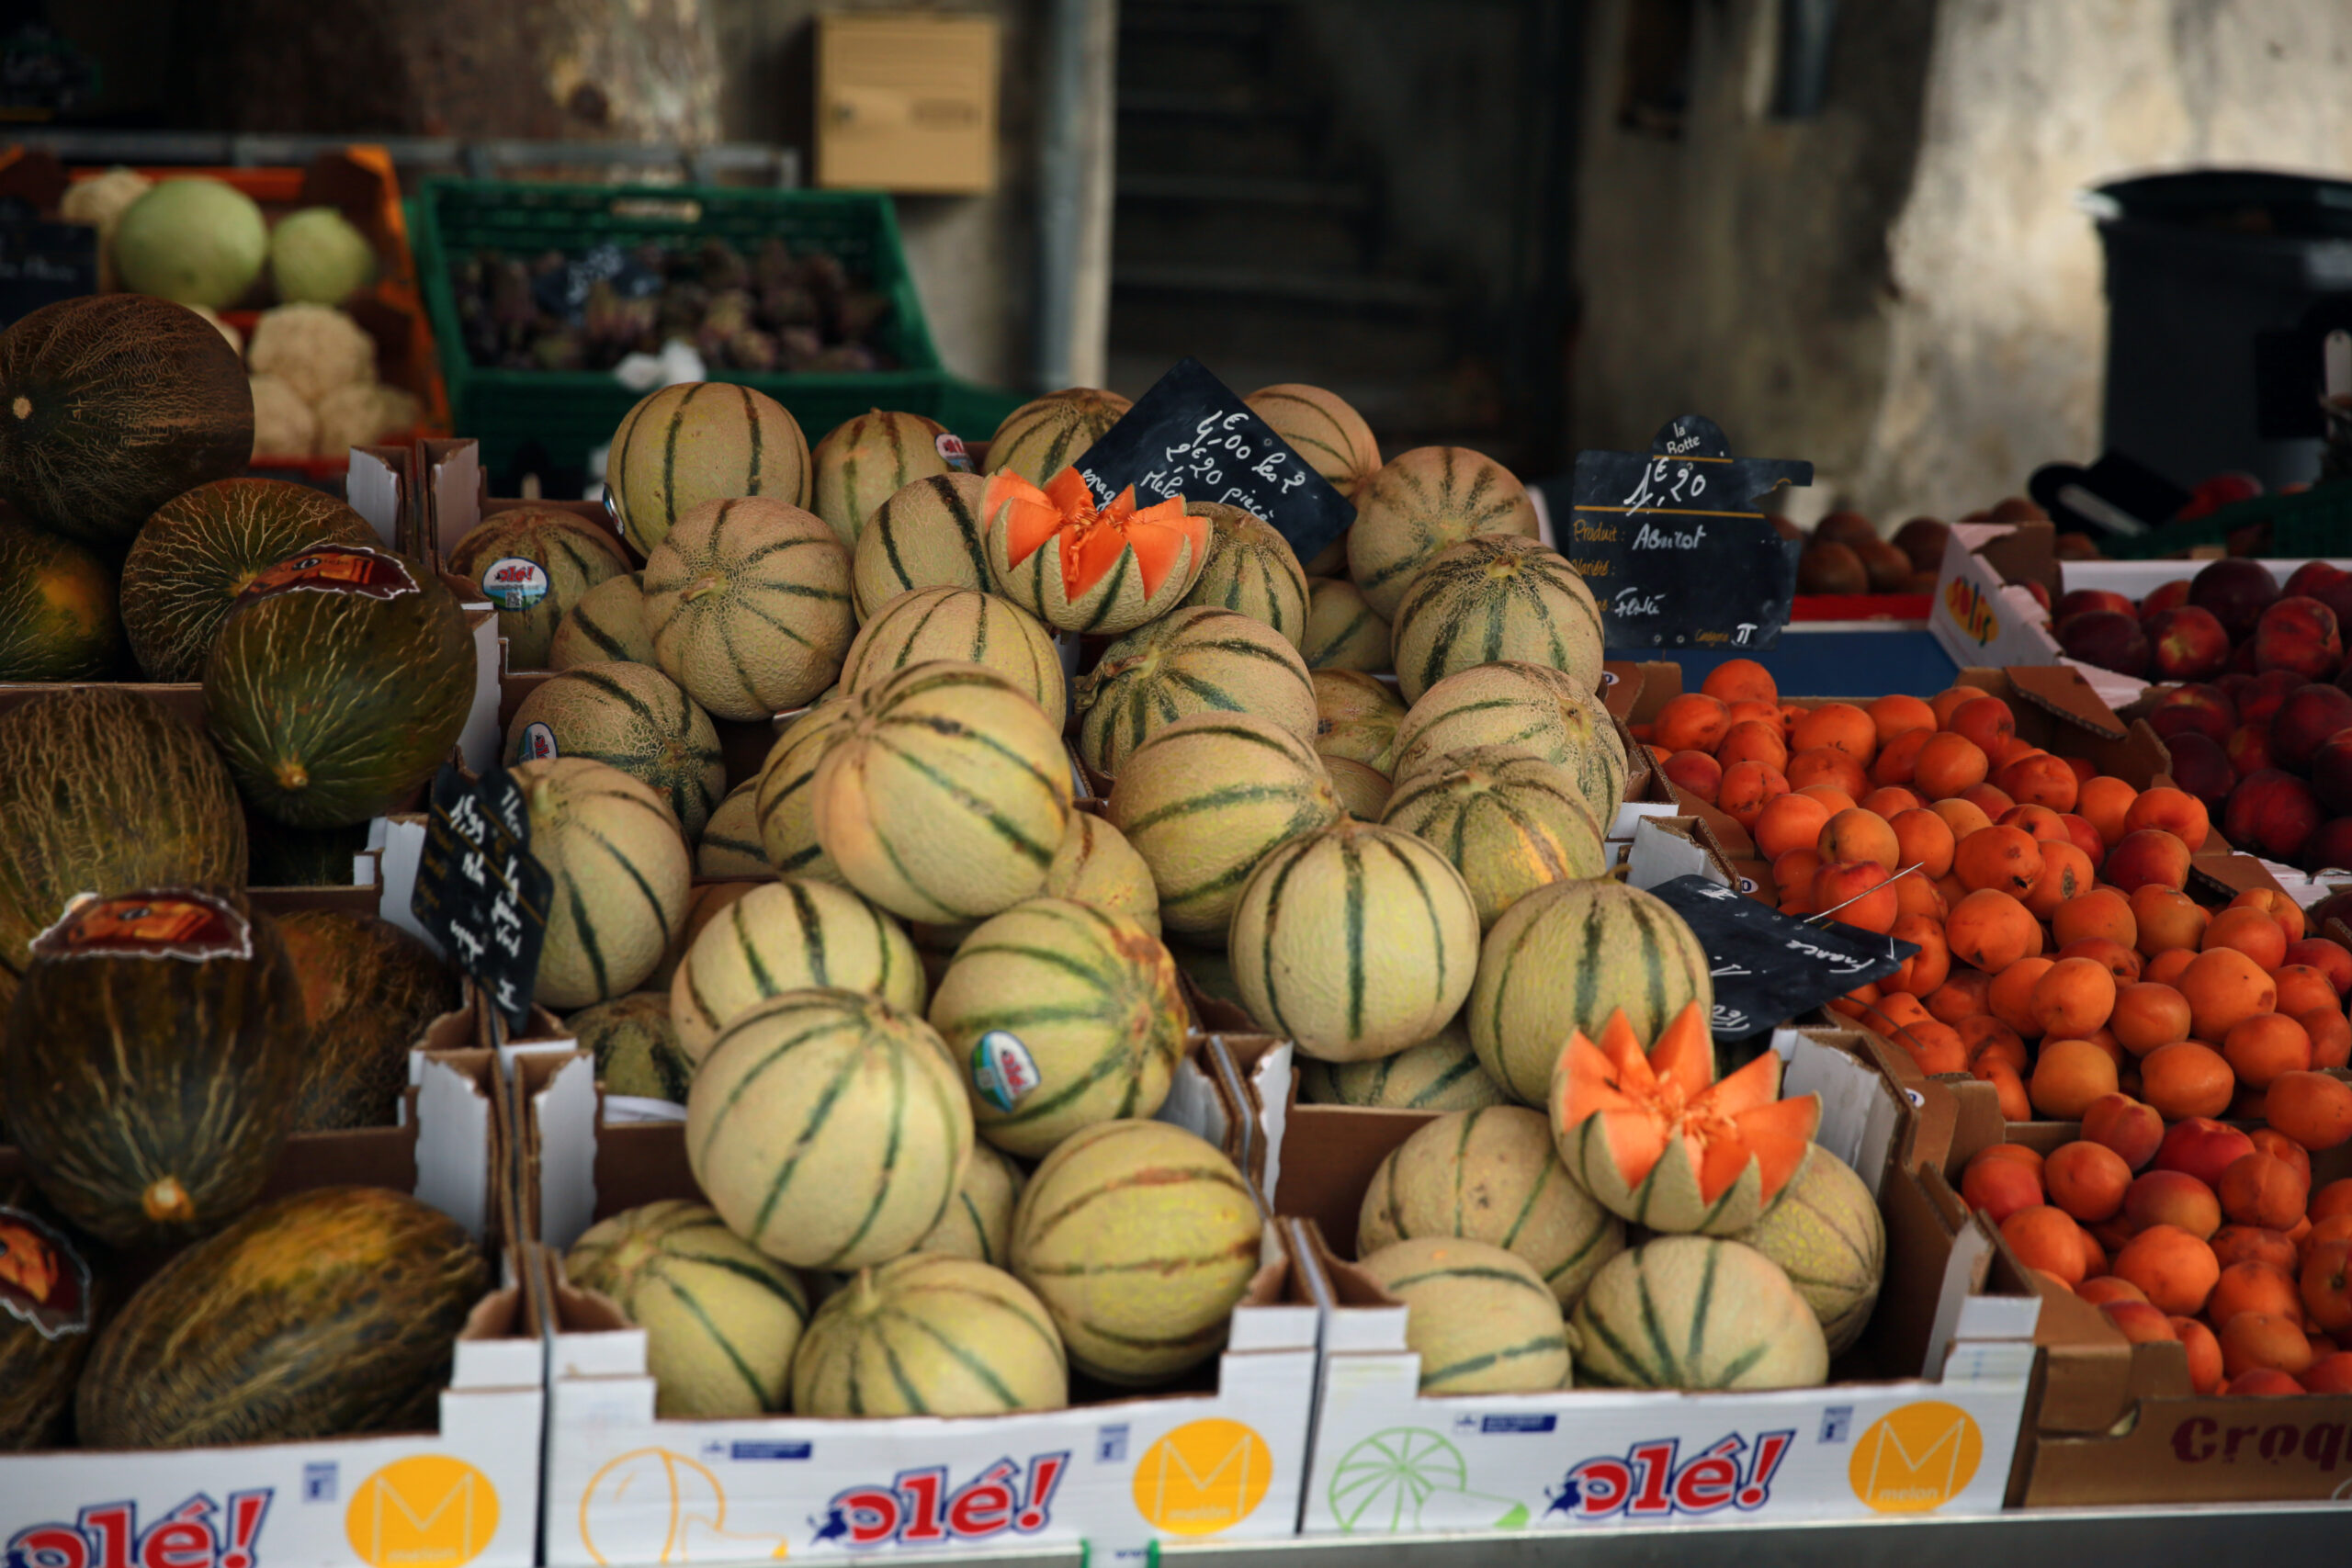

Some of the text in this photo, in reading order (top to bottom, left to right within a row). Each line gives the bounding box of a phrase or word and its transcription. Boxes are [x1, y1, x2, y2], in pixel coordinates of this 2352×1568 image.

[1667, 435, 1701, 455] Rotte
[1673, 423, 1686, 438] la
[1562, 1429, 1797, 1518] olé!
[2171, 1416, 2352, 1472] Croq
[6, 1487, 275, 1568] olé!
[825, 1450, 1071, 1547] olé!
